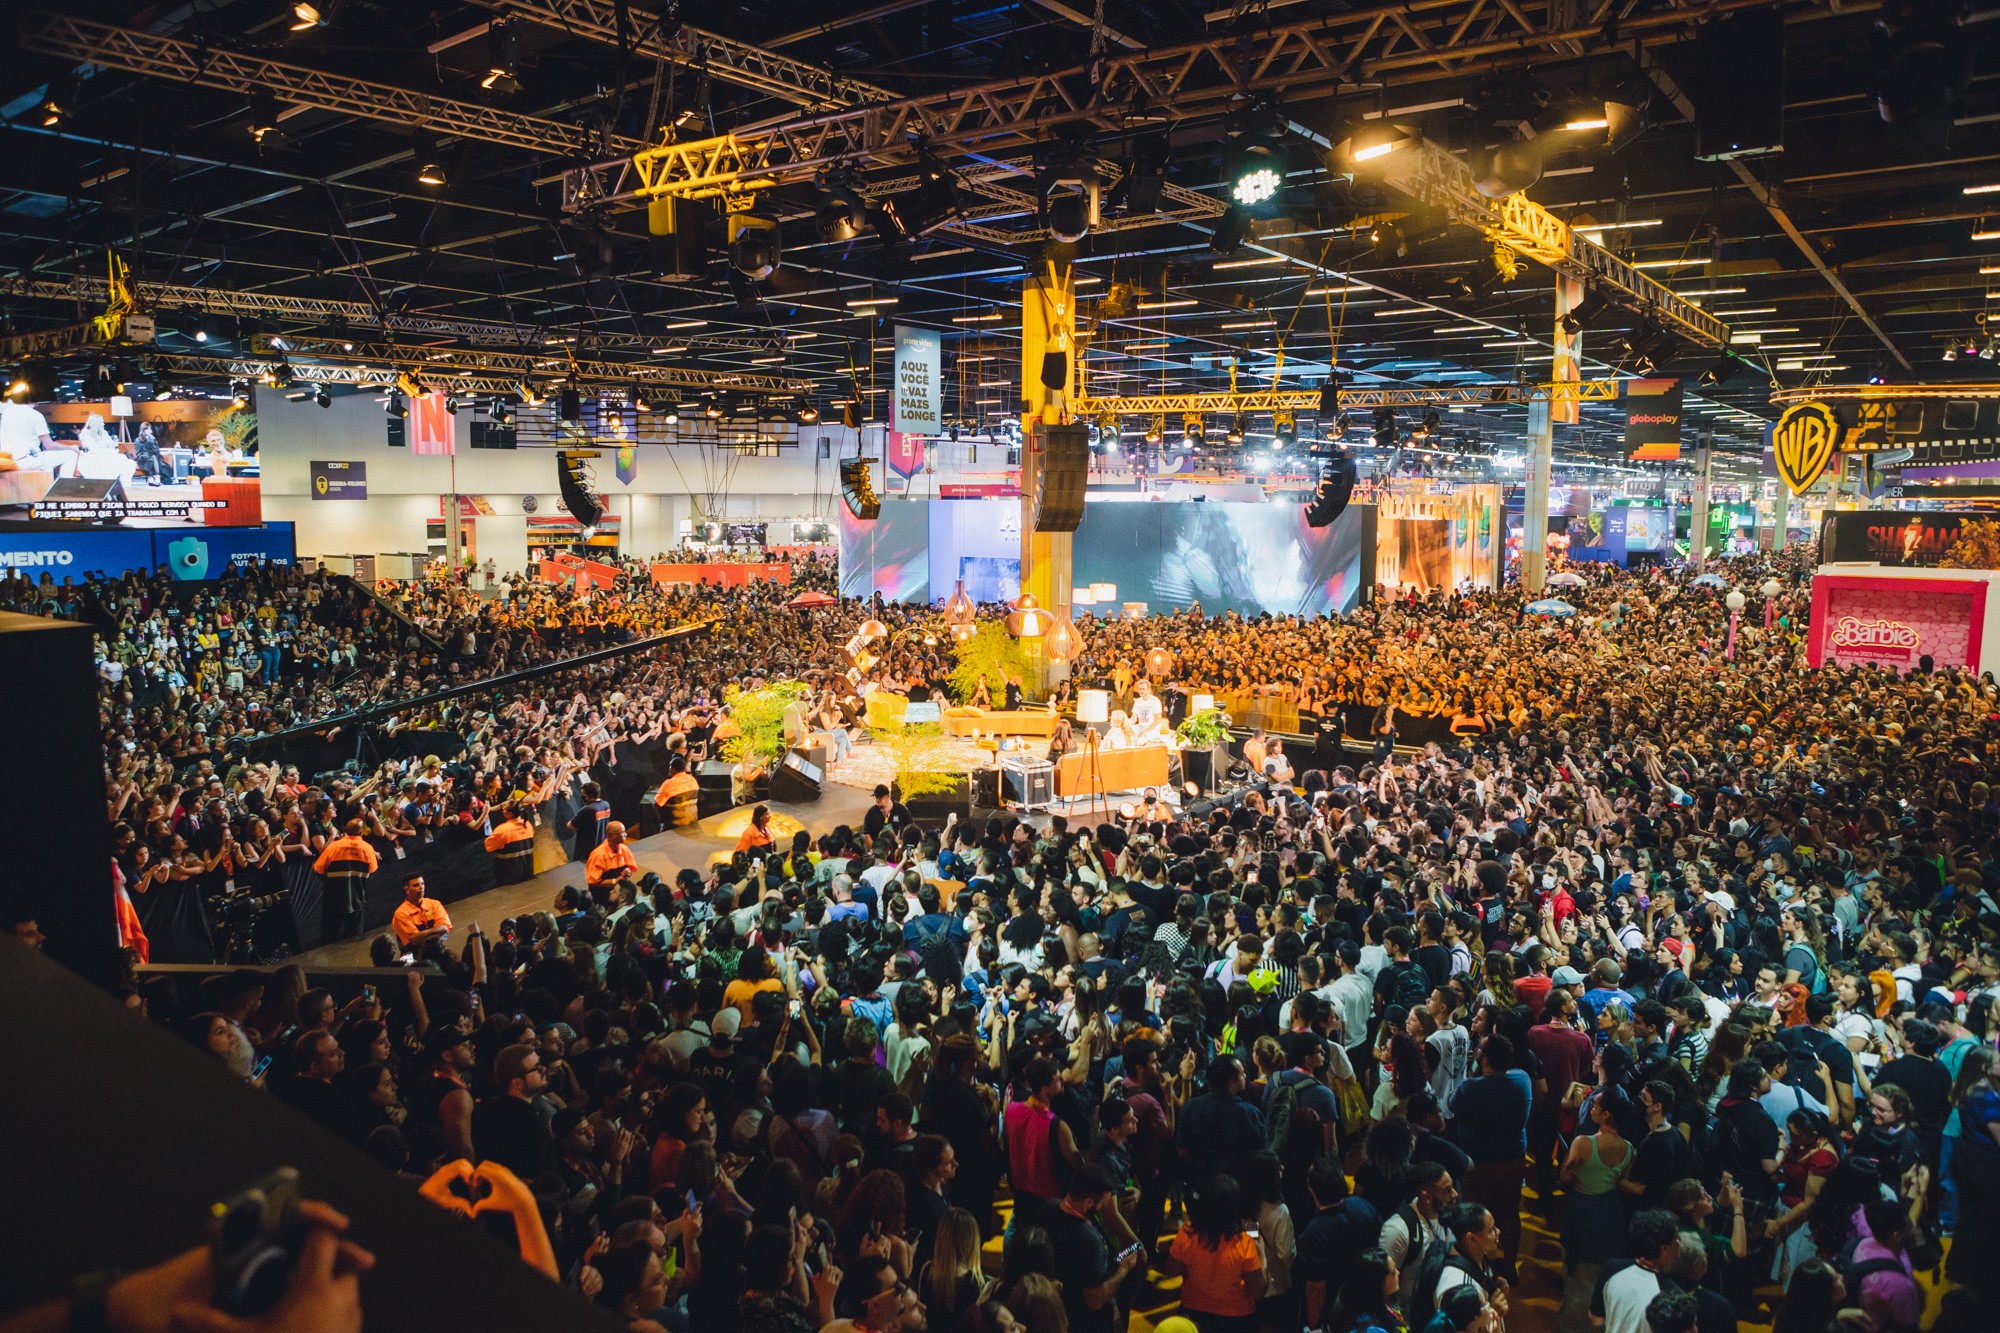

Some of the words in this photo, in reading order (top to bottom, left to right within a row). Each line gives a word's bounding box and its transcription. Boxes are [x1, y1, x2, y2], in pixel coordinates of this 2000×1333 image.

[901, 361, 928, 373] AQUI
[900, 374, 929, 385] VOCÊ
[908, 387, 927, 397] VAI
[901, 398, 930, 410] MAIS
[901, 409, 936, 422] LONGE
[1629, 414, 1678, 425] globoplay
[1781, 416, 1825, 480] WB
[191, 501, 215, 509] QUANDO
[35, 510, 62, 518] FIQUEI
[1867, 524, 1962, 552] SHAZAM
[1835, 619, 1915, 646] Barbie
